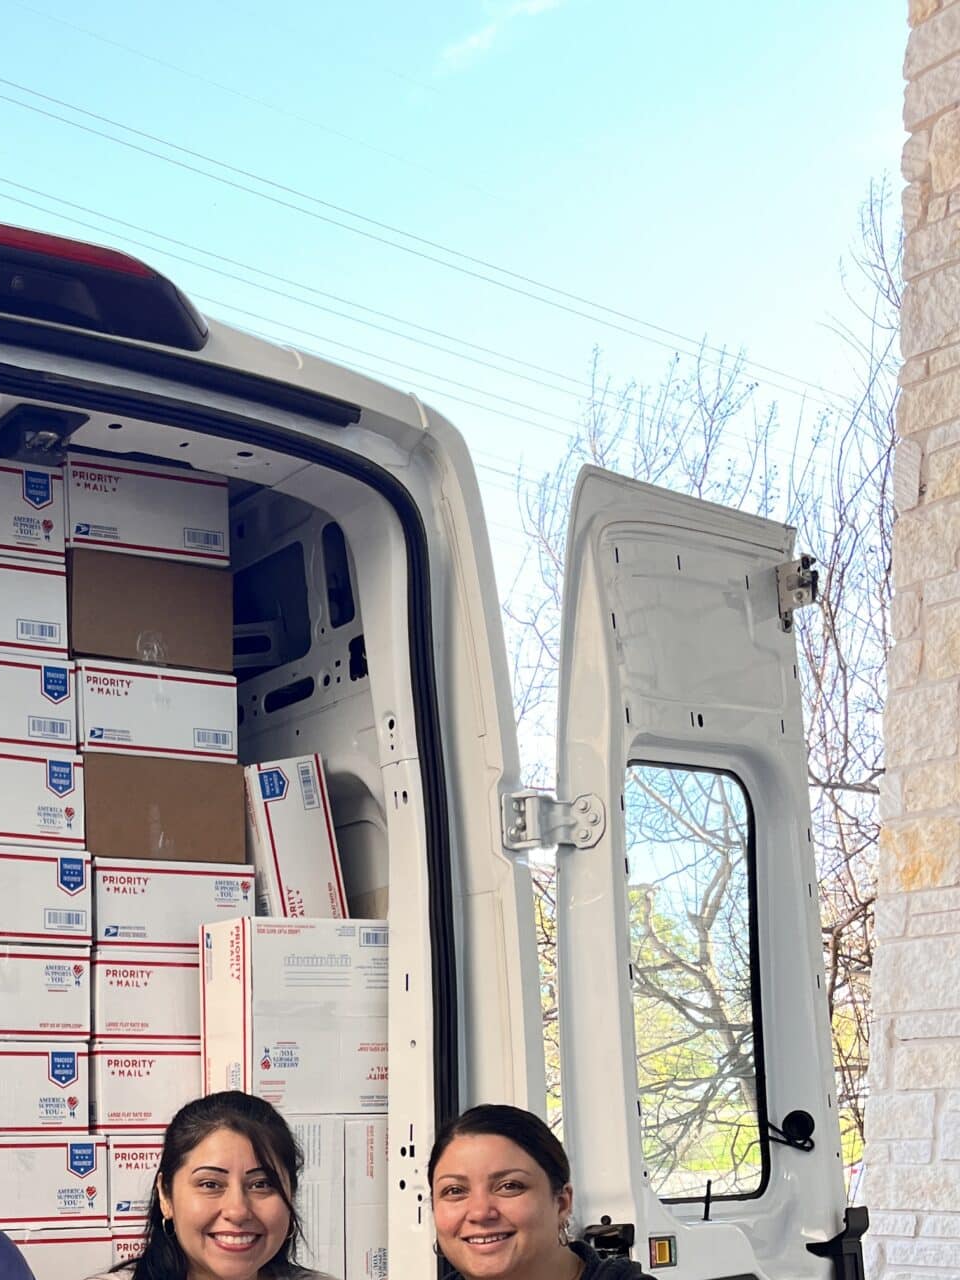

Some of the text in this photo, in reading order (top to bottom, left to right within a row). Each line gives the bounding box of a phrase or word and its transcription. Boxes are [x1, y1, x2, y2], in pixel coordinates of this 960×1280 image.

[72, 470, 120, 483] PRIORITY
[84, 483, 109, 492] MAIL
[86, 676, 131, 688] PRIORITY
[97, 687, 121, 696] MAIL
[103, 876, 149, 886] PRIORITY
[114, 886, 138, 895] MAIL
[106, 970, 152, 978] PRIORITY
[107, 1059, 153, 1068] PRIORITY
[115, 1153, 160, 1161] PRIORITY
